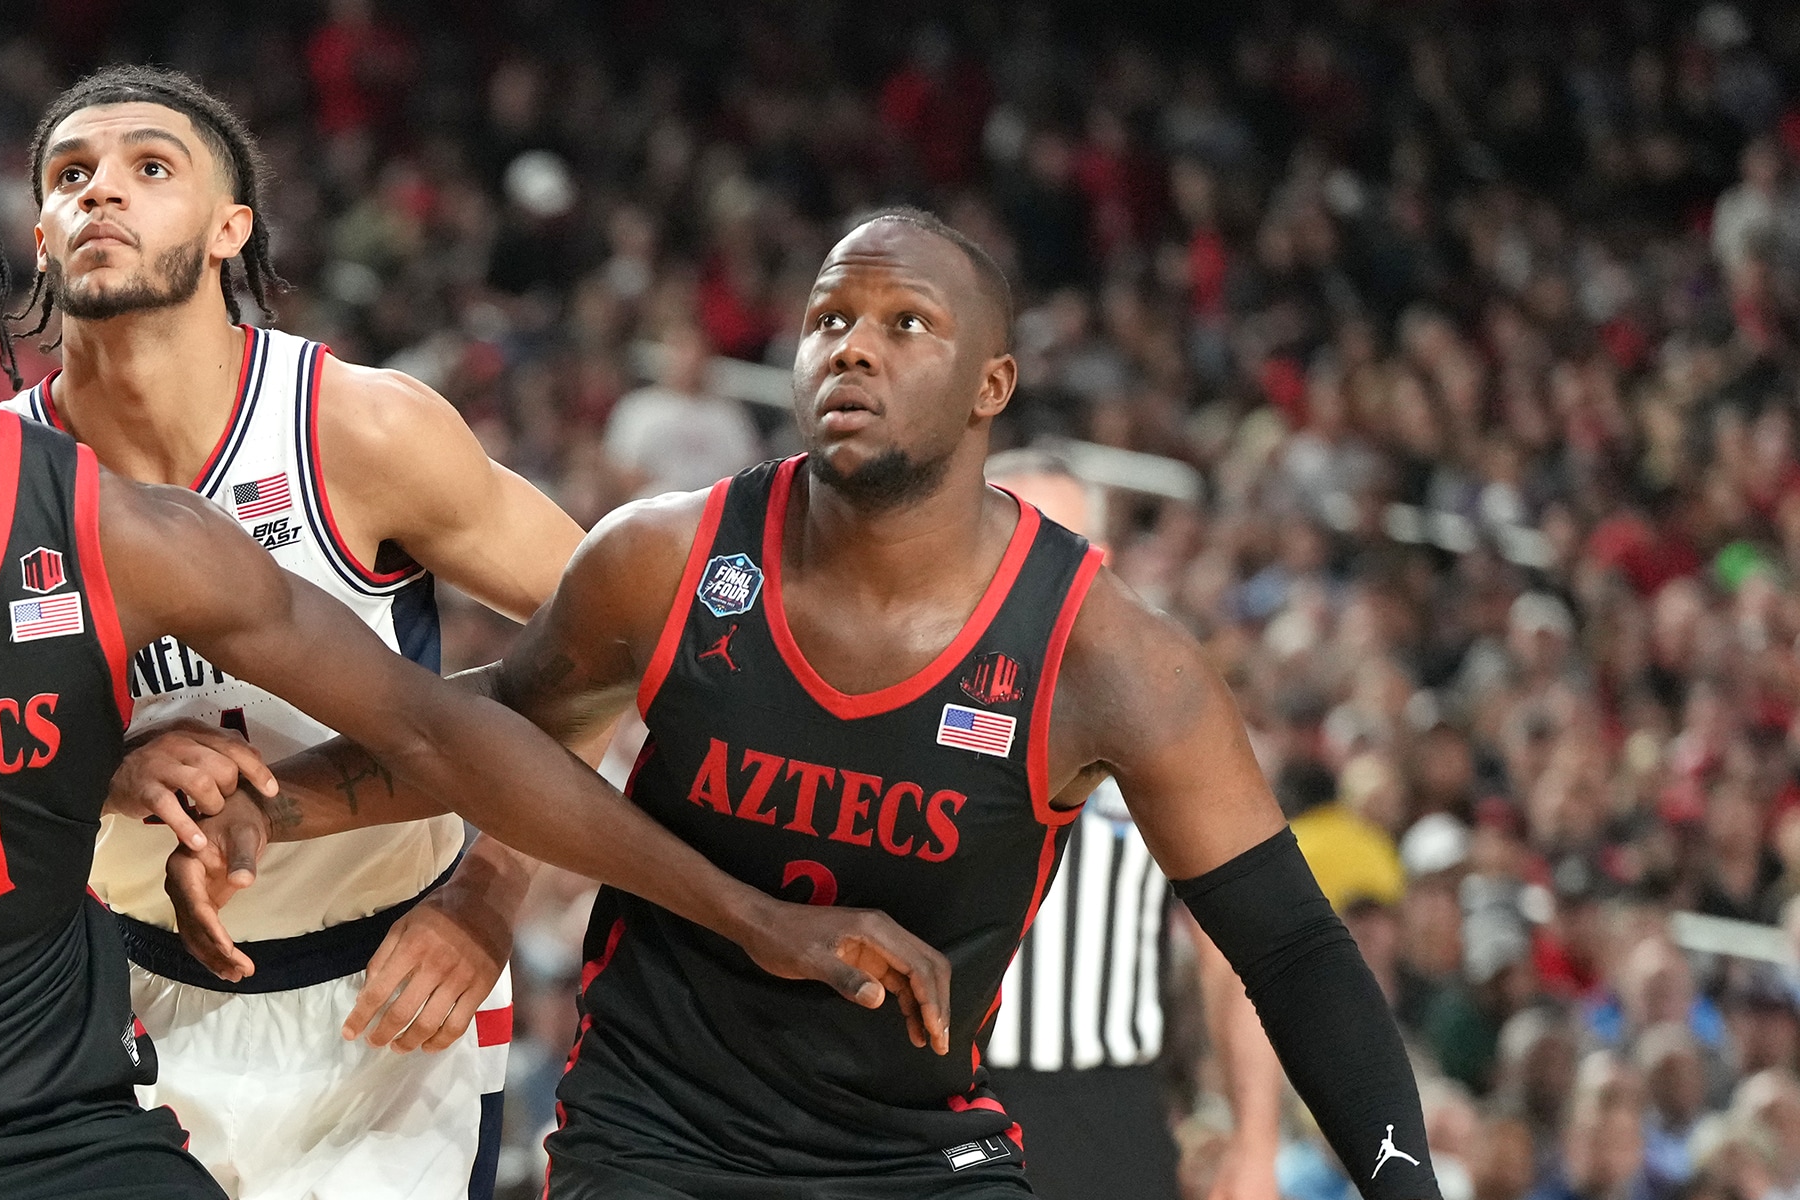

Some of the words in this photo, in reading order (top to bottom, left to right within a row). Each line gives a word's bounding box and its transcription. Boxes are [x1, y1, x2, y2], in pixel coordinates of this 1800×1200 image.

[253, 516, 289, 538] BIG
[714, 565, 753, 589] FINAL
[711, 579, 750, 602] FOUR
[687, 737, 967, 863] AZTECS
